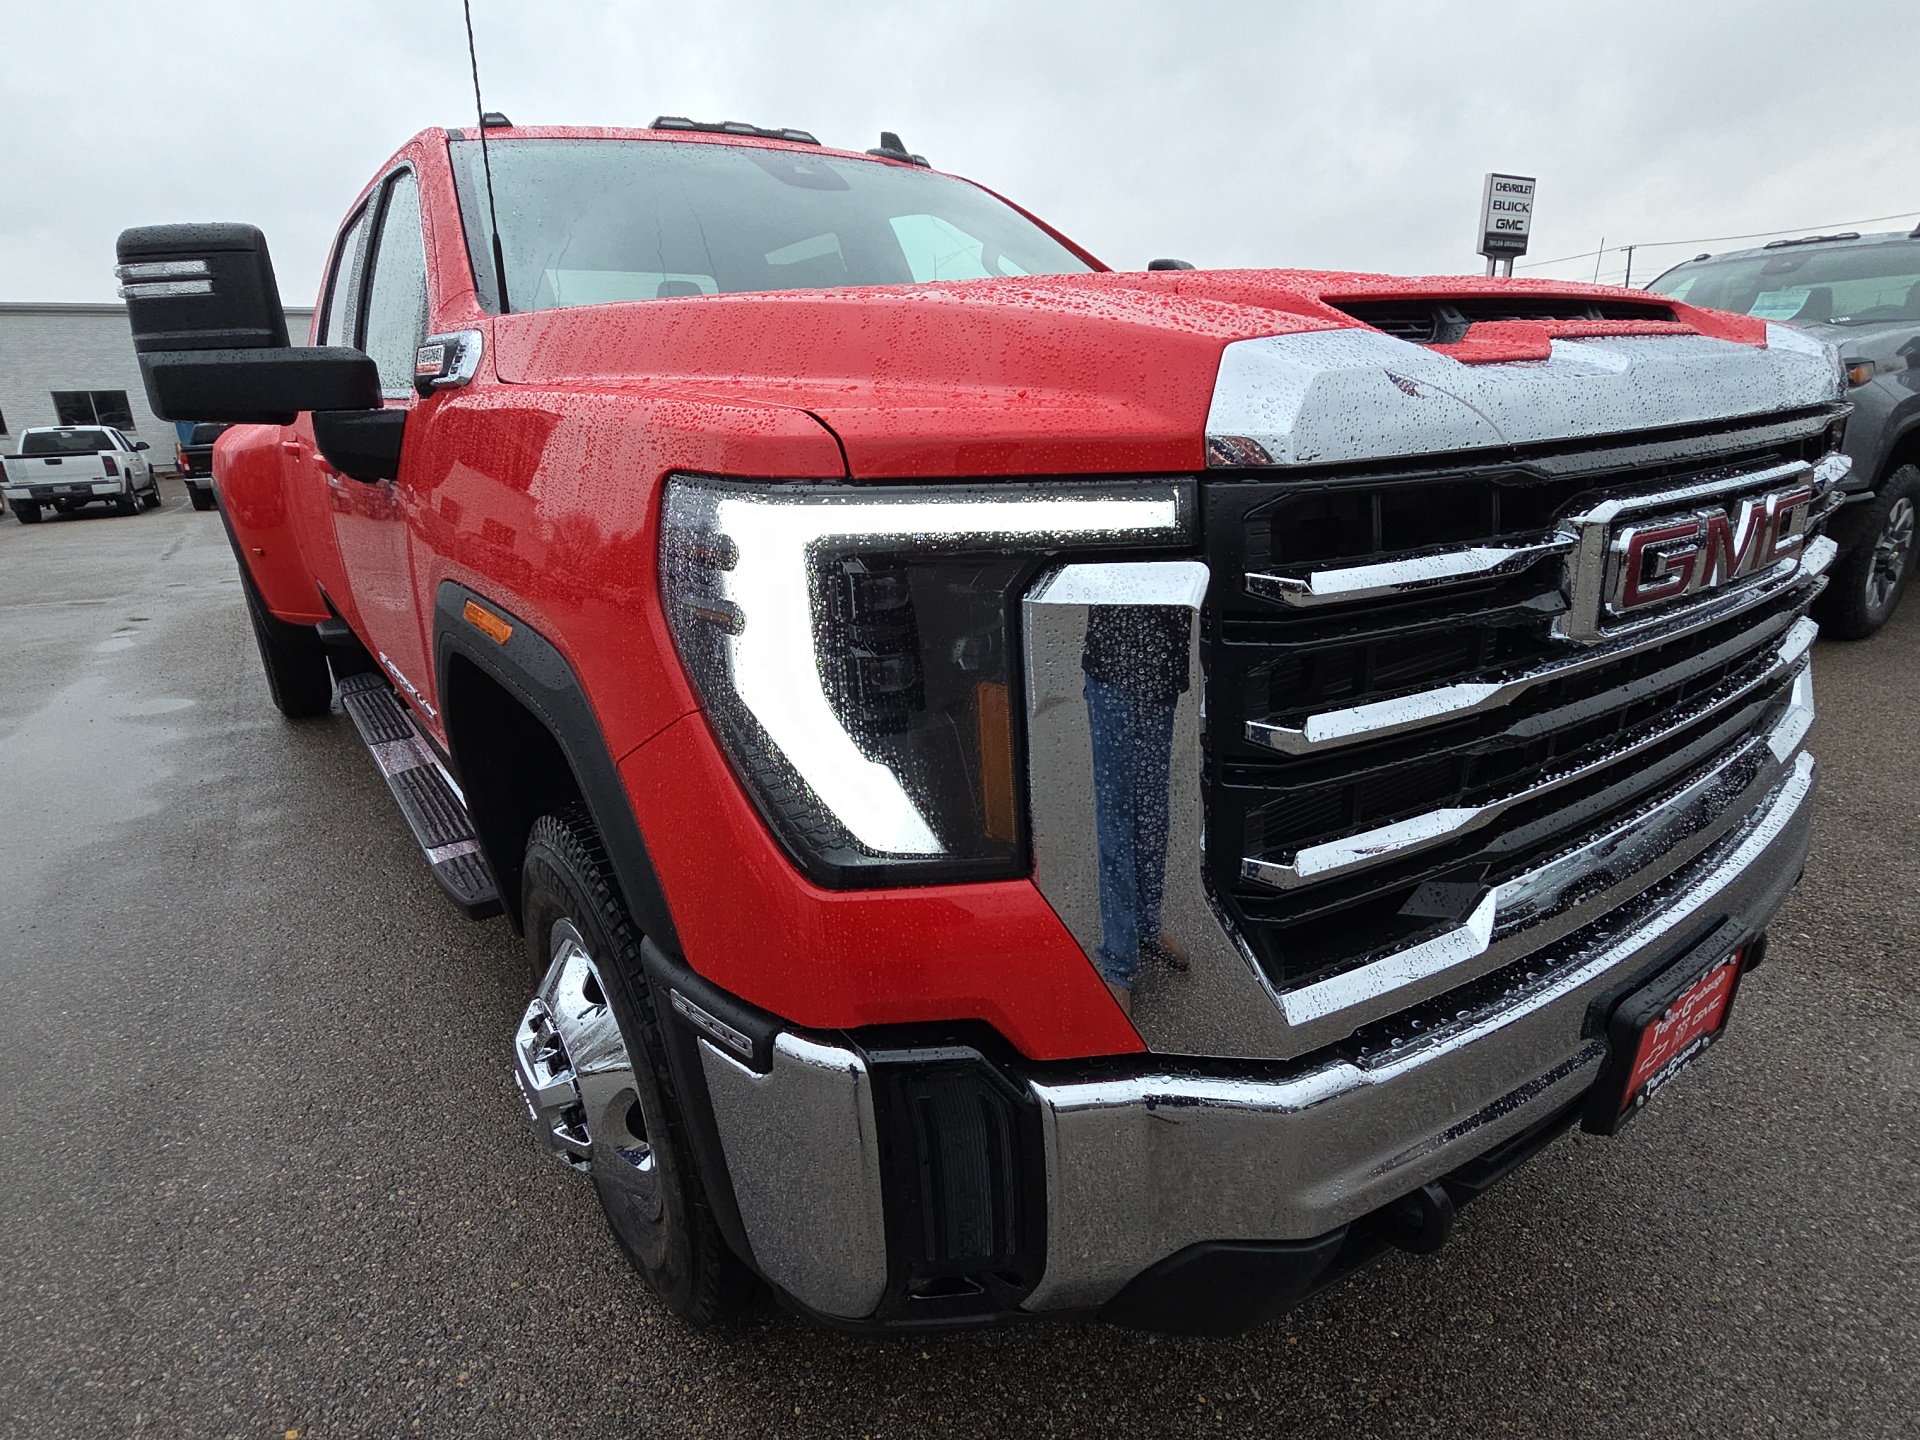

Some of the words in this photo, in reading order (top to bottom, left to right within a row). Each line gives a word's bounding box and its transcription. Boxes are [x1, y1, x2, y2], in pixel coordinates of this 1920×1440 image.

[1495, 182, 1532, 194] CHEVROLET
[1492, 200, 1530, 213] BUICK
[1495, 218, 1524, 231] GMC
[1615, 486, 1812, 610] GMC
[1692, 994, 1722, 1026] GMC
[674, 997, 748, 1052] 3500
